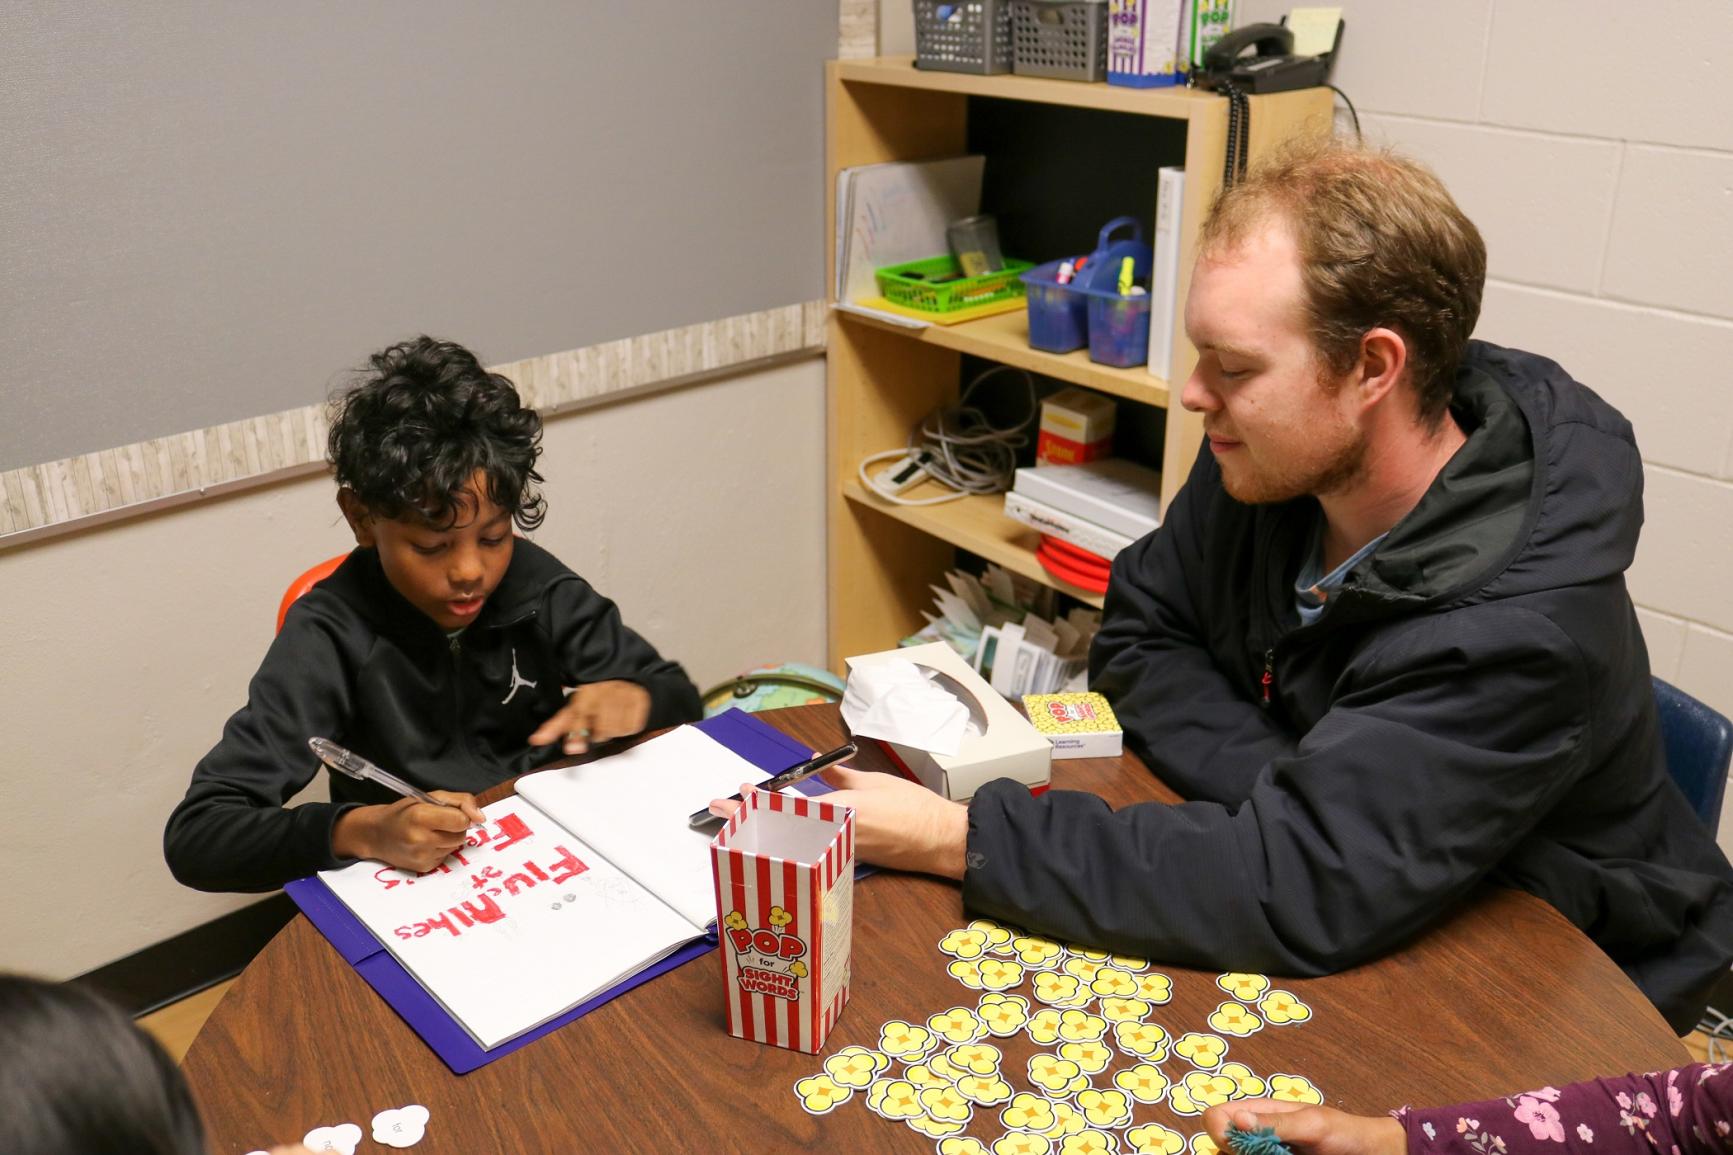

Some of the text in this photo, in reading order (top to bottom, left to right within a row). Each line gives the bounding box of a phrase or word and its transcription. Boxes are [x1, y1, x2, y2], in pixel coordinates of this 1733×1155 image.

[728, 928, 806, 961] POP
[759, 958, 775, 968] for
[739, 976, 798, 1000] WORDS
[743, 967, 794, 988] SIGHT
